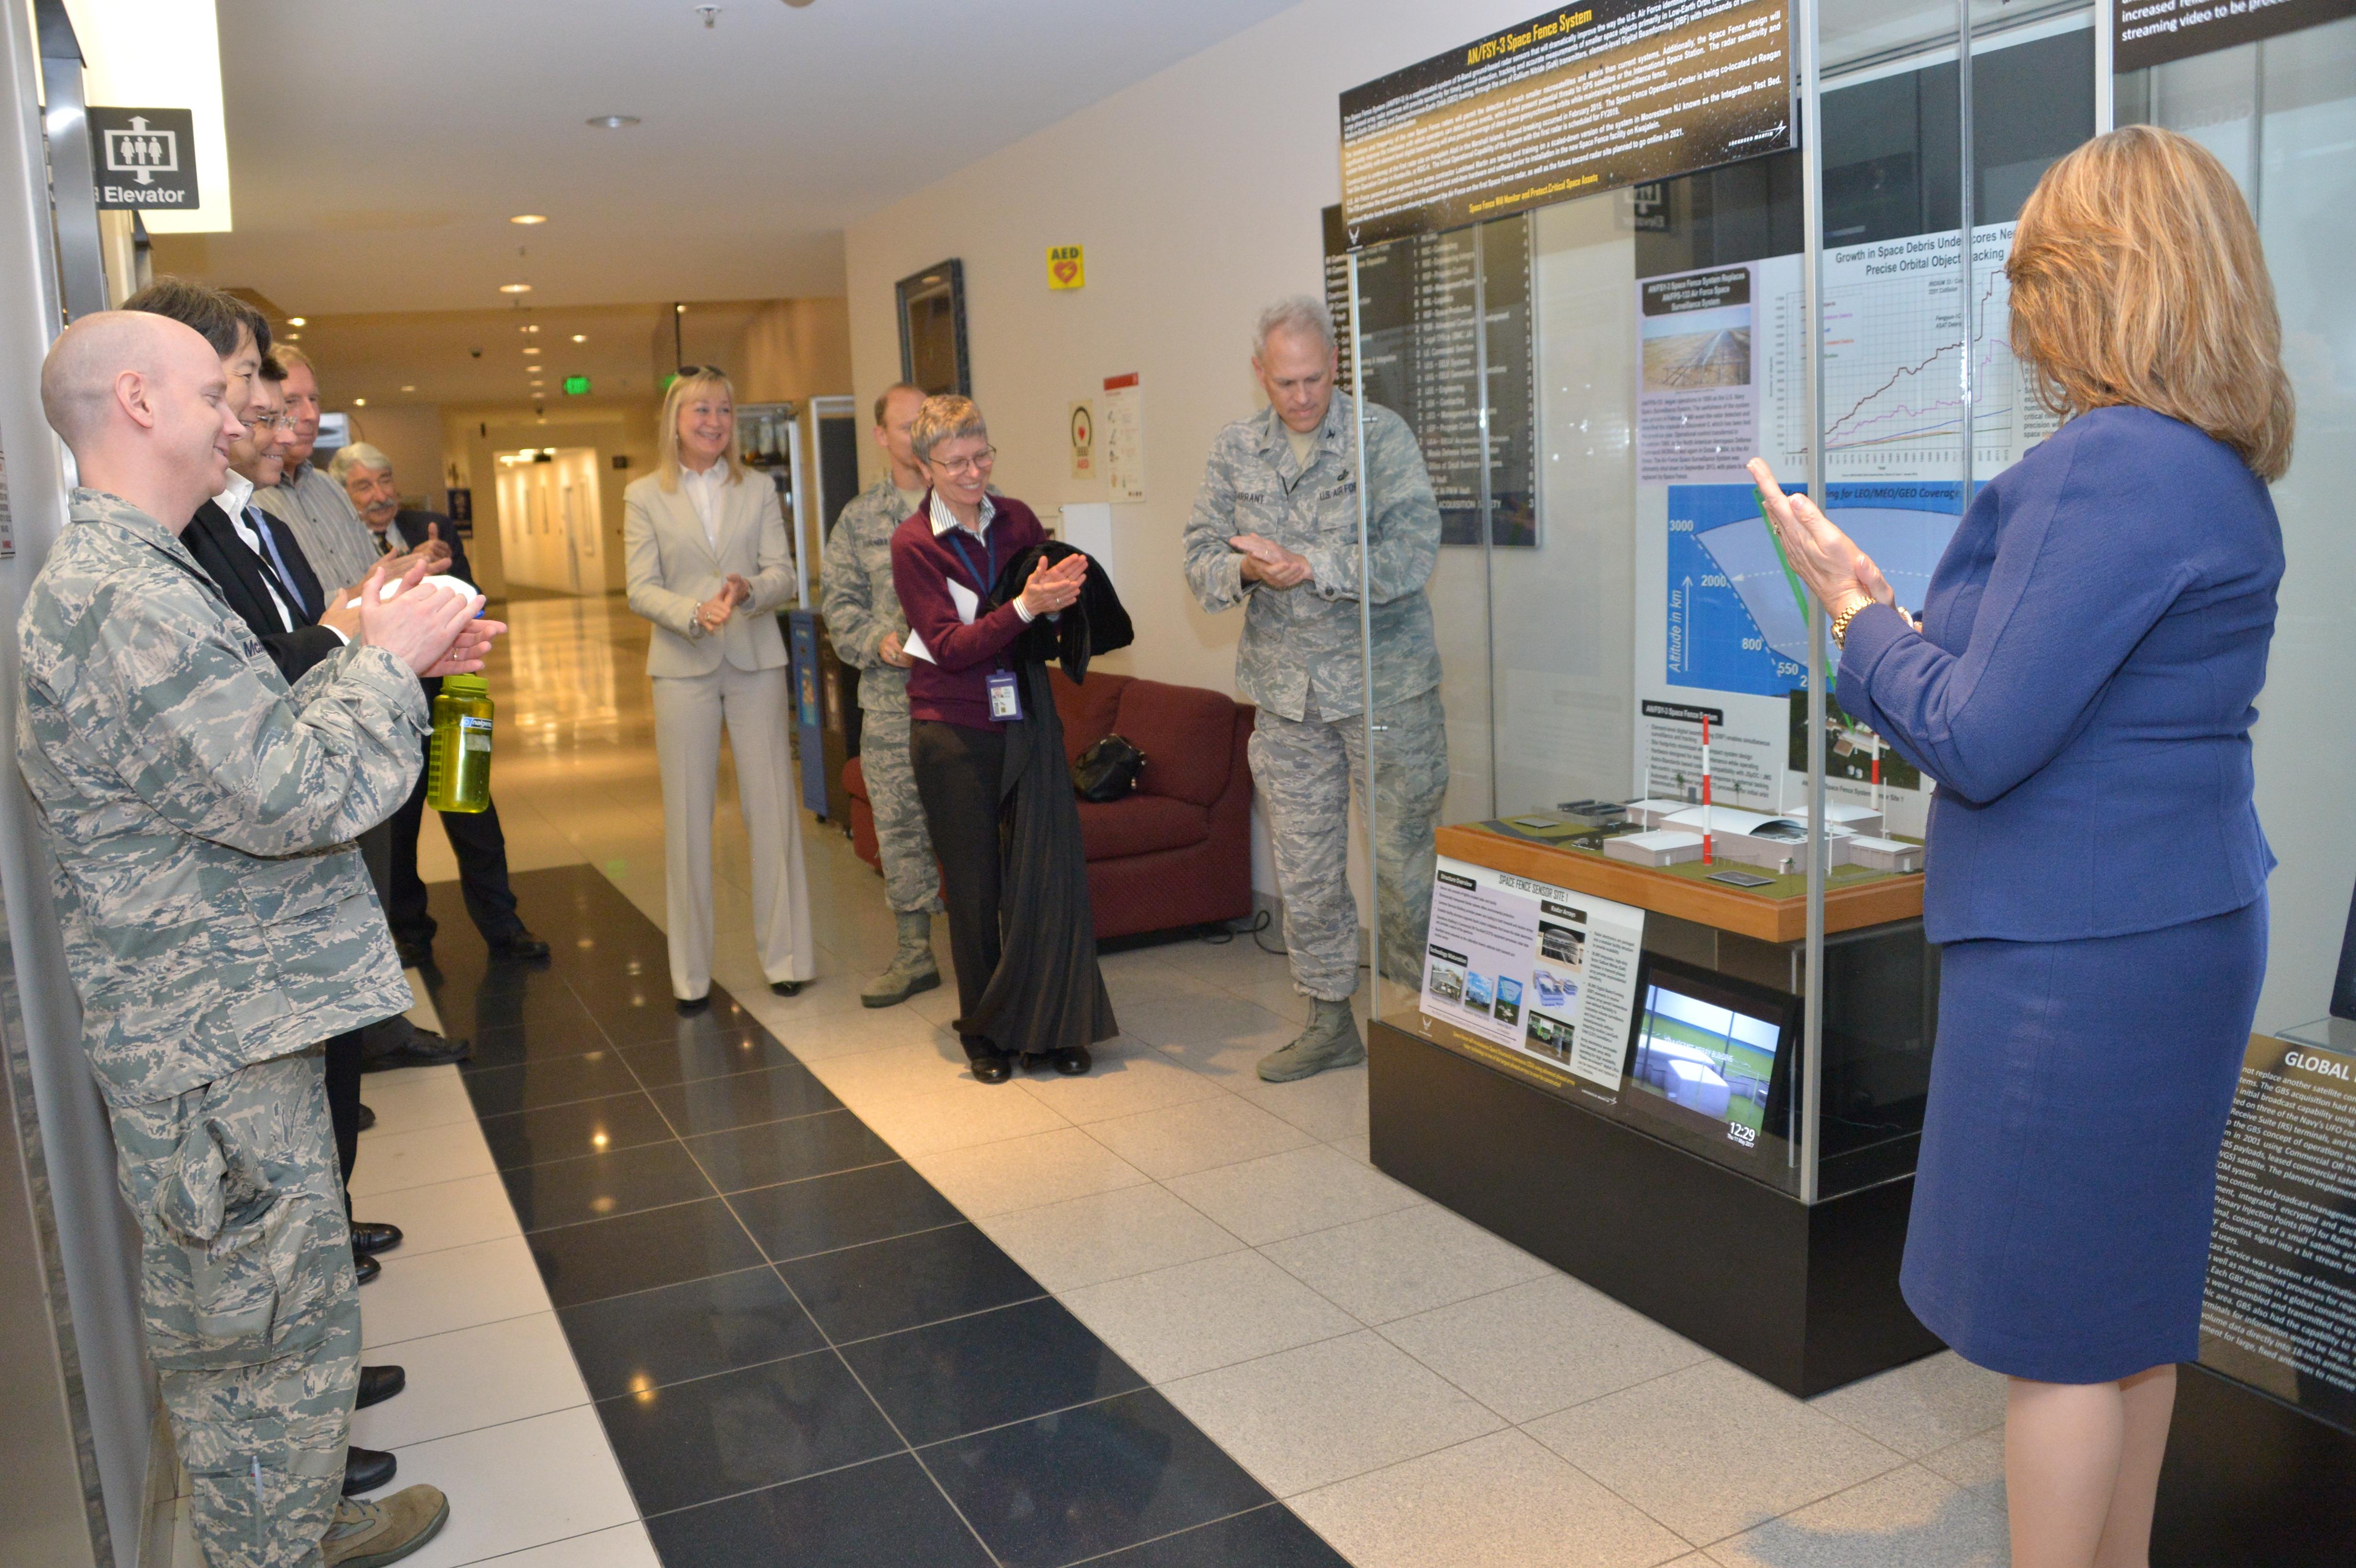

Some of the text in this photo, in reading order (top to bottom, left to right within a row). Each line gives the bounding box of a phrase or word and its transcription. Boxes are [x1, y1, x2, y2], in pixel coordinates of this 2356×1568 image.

[1617, 16, 1625, 24] the
[1626, 12, 1637, 22] U.S.
[1647, 5, 1661, 15] Force
[2122, 1, 2175, 22] increased
[2122, 1, 2246, 41] streaming video to be
[1468, 10, 1592, 65] AN/FSY-3 Space Fence System
[1664, 11, 1780, 54] Additionally, the Space Fence design will
[1667, 22, 1780, 65] Space Station. The radar sensitivity and
[1679, 76, 1696, 85] Center
[1704, 69, 1719, 78] being
[1721, 58, 1750, 73] co-located
[1759, 52, 1781, 62] Reagan
[1674, 103, 1681, 112] NJ
[1683, 100, 1701, 109] known
[1711, 94, 1720, 102] the
[1721, 86, 1751, 99] Integration
[1754, 81, 1766, 90] Test
[1768, 76, 1781, 86] Bed.
[1729, 132, 1773, 146] LOCKHEED MARTIN
[104, 186, 185, 203] Elevator
[1530, 186, 1547, 197] Protect
[1549, 180, 1565, 192] Critical
[1566, 178, 1581, 189] Space
[1582, 174, 1598, 185] Assets
[1051, 247, 1079, 260] AED
[1836, 231, 1996, 263] Growth in Space Debris Undecores
[1866, 249, 2004, 275] Precise Orbital Object acking
[1320, 487, 1343, 500] U.S. AIR
[1841, 488, 1960, 500] for LEO/MEO/GEO Coverage
[1669, 520, 1693, 532] 3000
[1702, 575, 1727, 587] 2000
[1669, 589, 1682, 673] Altitude in km
[1742, 638, 1762, 651] 800
[1778, 662, 1799, 675] 550
[1457, 878, 1472, 887] Overview
[1499, 875, 1515, 887] SPACE
[1516, 880, 1531, 892] FENCE
[1532, 884, 1553, 899] SENSOR
[1554, 890, 1565, 902] SITE
[1551, 905, 1576, 918] Radar Arrays
[1712, 1050, 1734, 1062] BUILDING
[2285, 1052, 2349, 1080] GLOBAL
[2256, 1071, 2281, 1082] replace
[2283, 1078, 2311, 1090] another
[2312, 1087, 2342, 1098] satellite
[2261, 1081, 2347, 1111] The GBS acquisition had
[2240, 1087, 2355, 1128] initial broadcast capability using
[2257, 1105, 2276, 1115] three
[2287, 1113, 2299, 1122] the
[2300, 1116, 2323, 1129] Navy's
[2325, 1123, 2342, 1134] UFO
[1730, 1122, 1755, 1142] 12:29
[2231, 1107, 2347, 1148] Receive Suite (RS) terminals, and
[2234, 1121, 2246, 1129] the
[2247, 1123, 2261, 1133] GBS
[2263, 1130, 2291, 1143] concept
[2303, 1142, 2343, 1158] operations
[2225, 1245, 2250, 1261] Service
[2253, 1258, 2267, 1266] was
[2275, 1266, 2301, 1279] system
